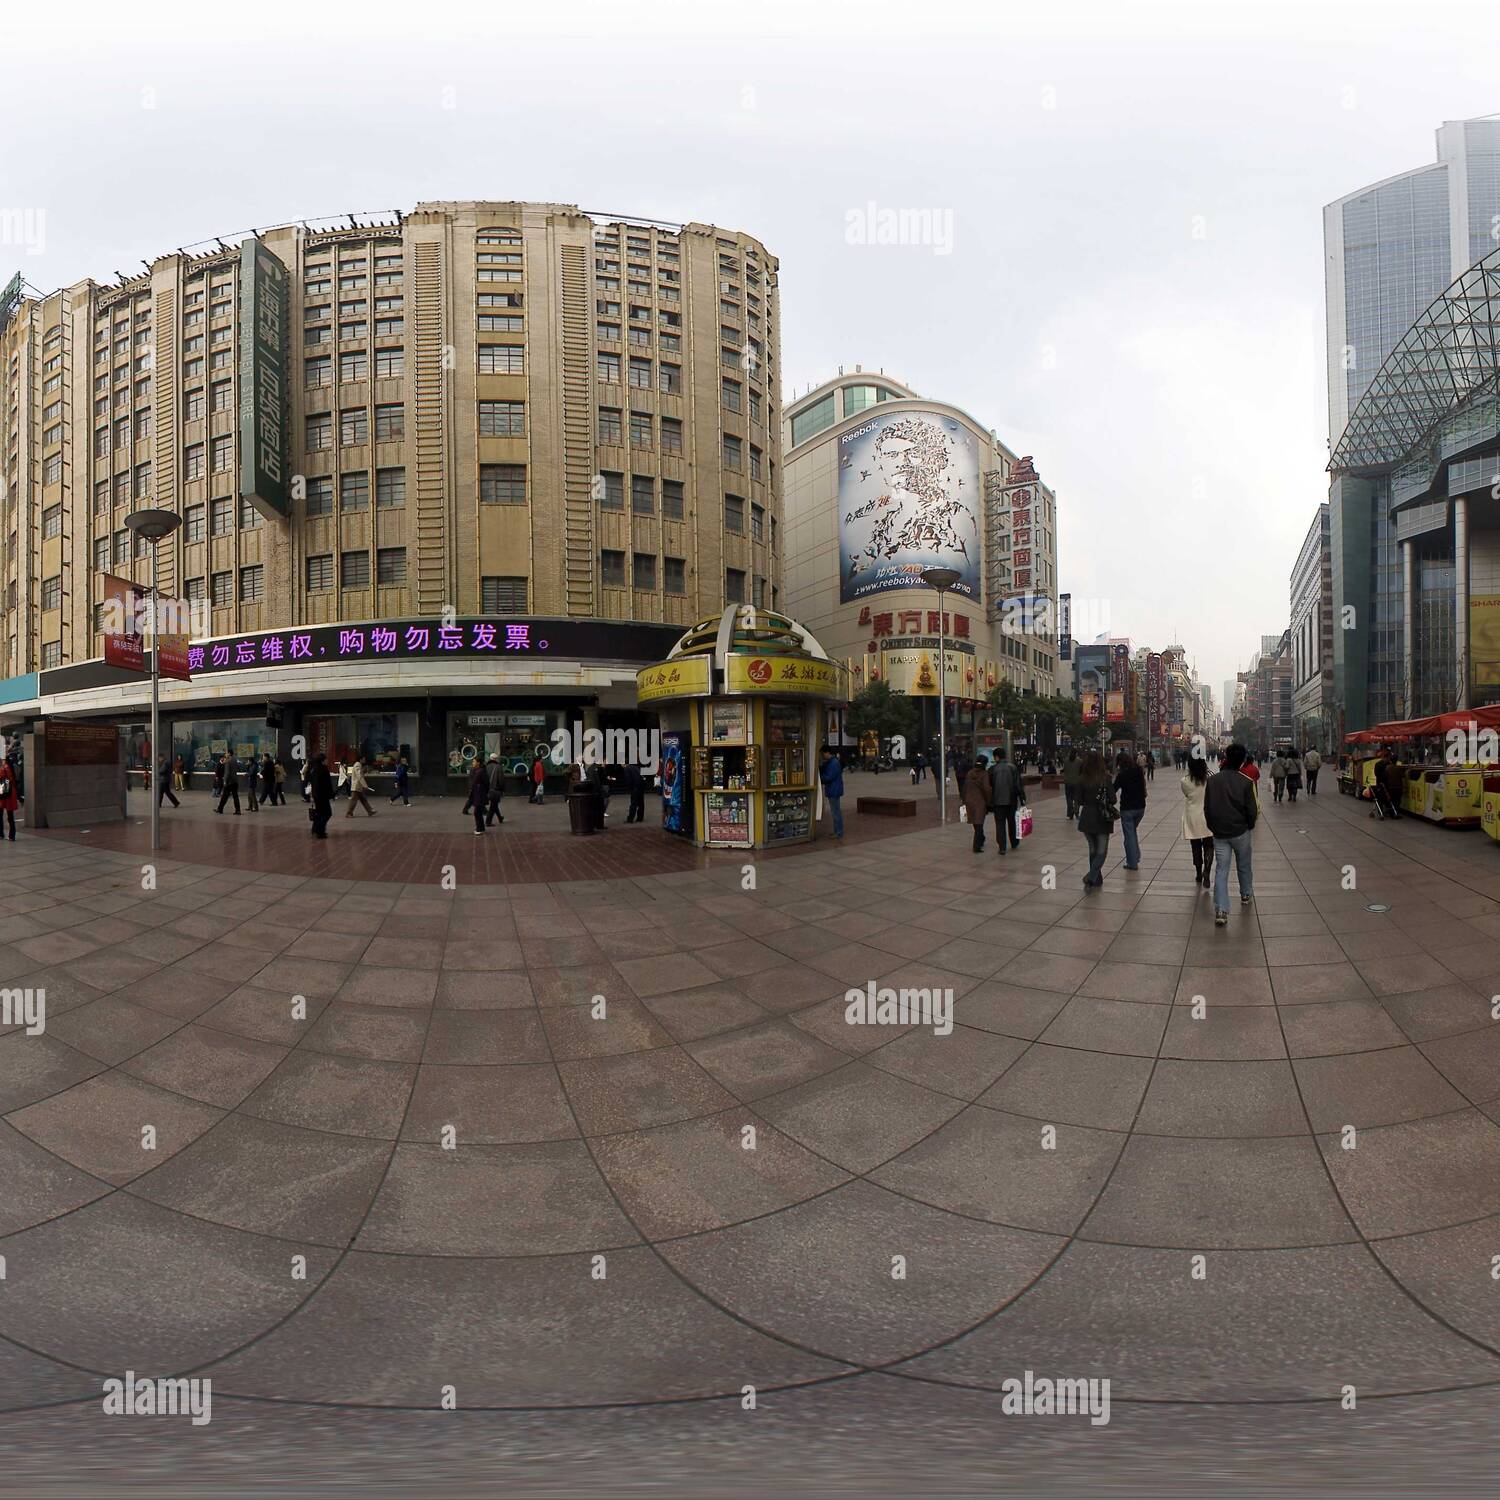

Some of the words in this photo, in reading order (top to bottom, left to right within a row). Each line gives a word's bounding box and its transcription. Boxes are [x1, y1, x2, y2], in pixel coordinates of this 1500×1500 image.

[242, 385, 254, 421] STORE
[841, 421, 880, 445] Reebok
[890, 656, 920, 664] HAPPY
[319, 722, 327, 756] CROW
